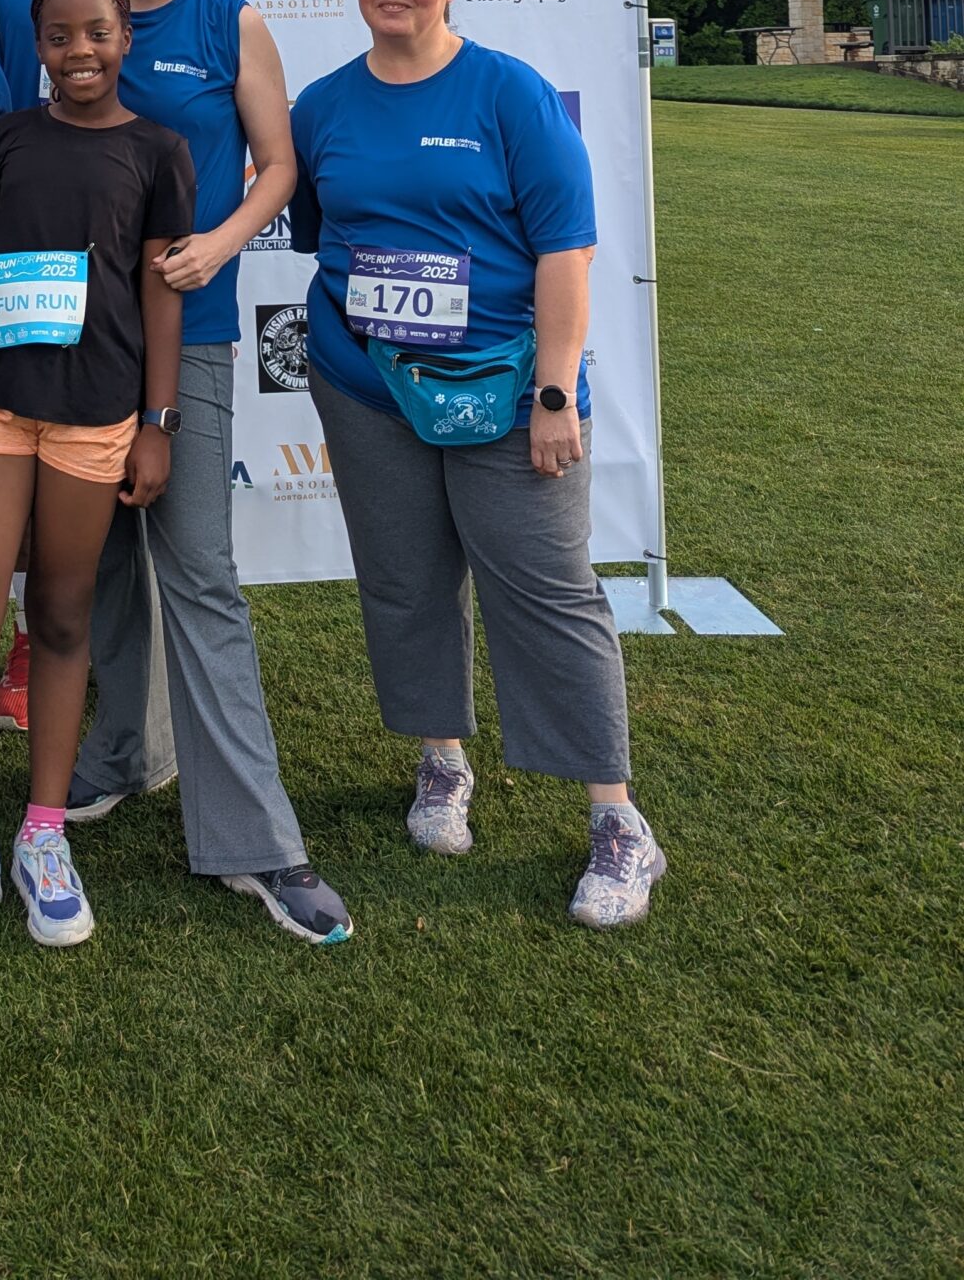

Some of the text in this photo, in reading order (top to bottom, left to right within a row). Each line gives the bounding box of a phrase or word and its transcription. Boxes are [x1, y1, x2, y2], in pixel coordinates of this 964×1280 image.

[261, 12, 299, 20] ORTGAGE
[310, 11, 344, 19] LENDING
[420, 136, 456, 147] BUTLER
[36, 253, 77, 264] HUNGER
[356, 251, 459, 267] HOPE RUN FOR HUNGER
[41, 264, 77, 277] 2025
[421, 265, 459, 280] 2025
[35, 293, 77, 311] RUN
[373, 283, 434, 317] 170
[265, 310, 295, 339] RISING
[273, 480, 338, 491] ABSOL
